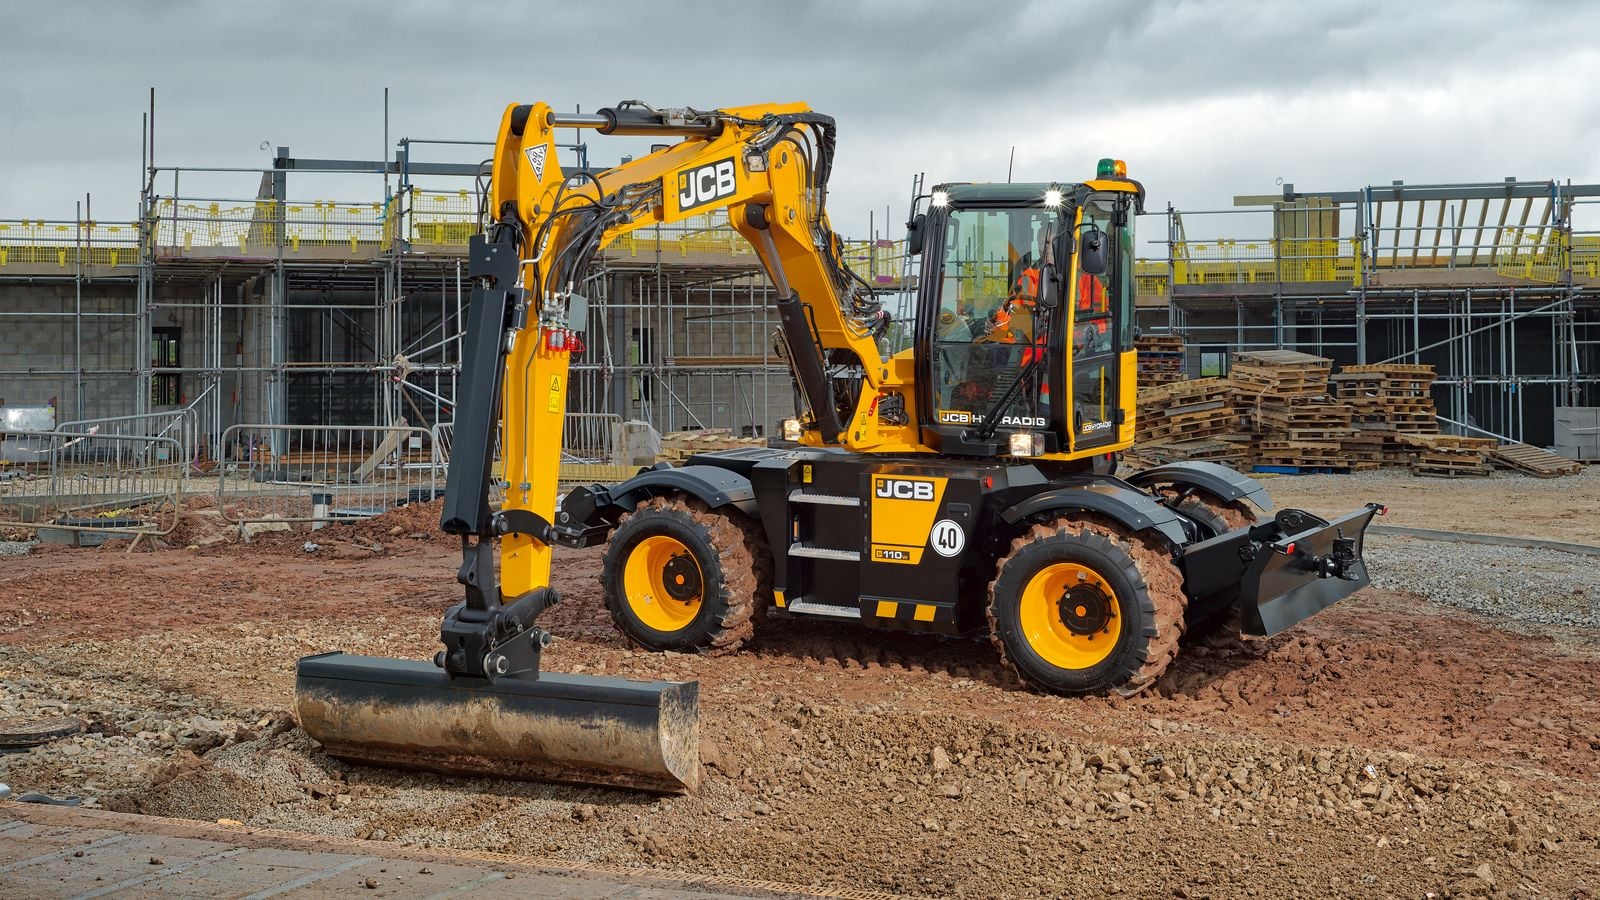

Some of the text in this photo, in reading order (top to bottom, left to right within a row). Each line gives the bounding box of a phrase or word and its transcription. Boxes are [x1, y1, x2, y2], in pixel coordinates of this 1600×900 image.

[680, 161, 735, 207] JCB
[941, 413, 1046, 426] JCB HRADIG
[877, 480, 934, 500] JCB
[938, 527, 957, 549] 40
